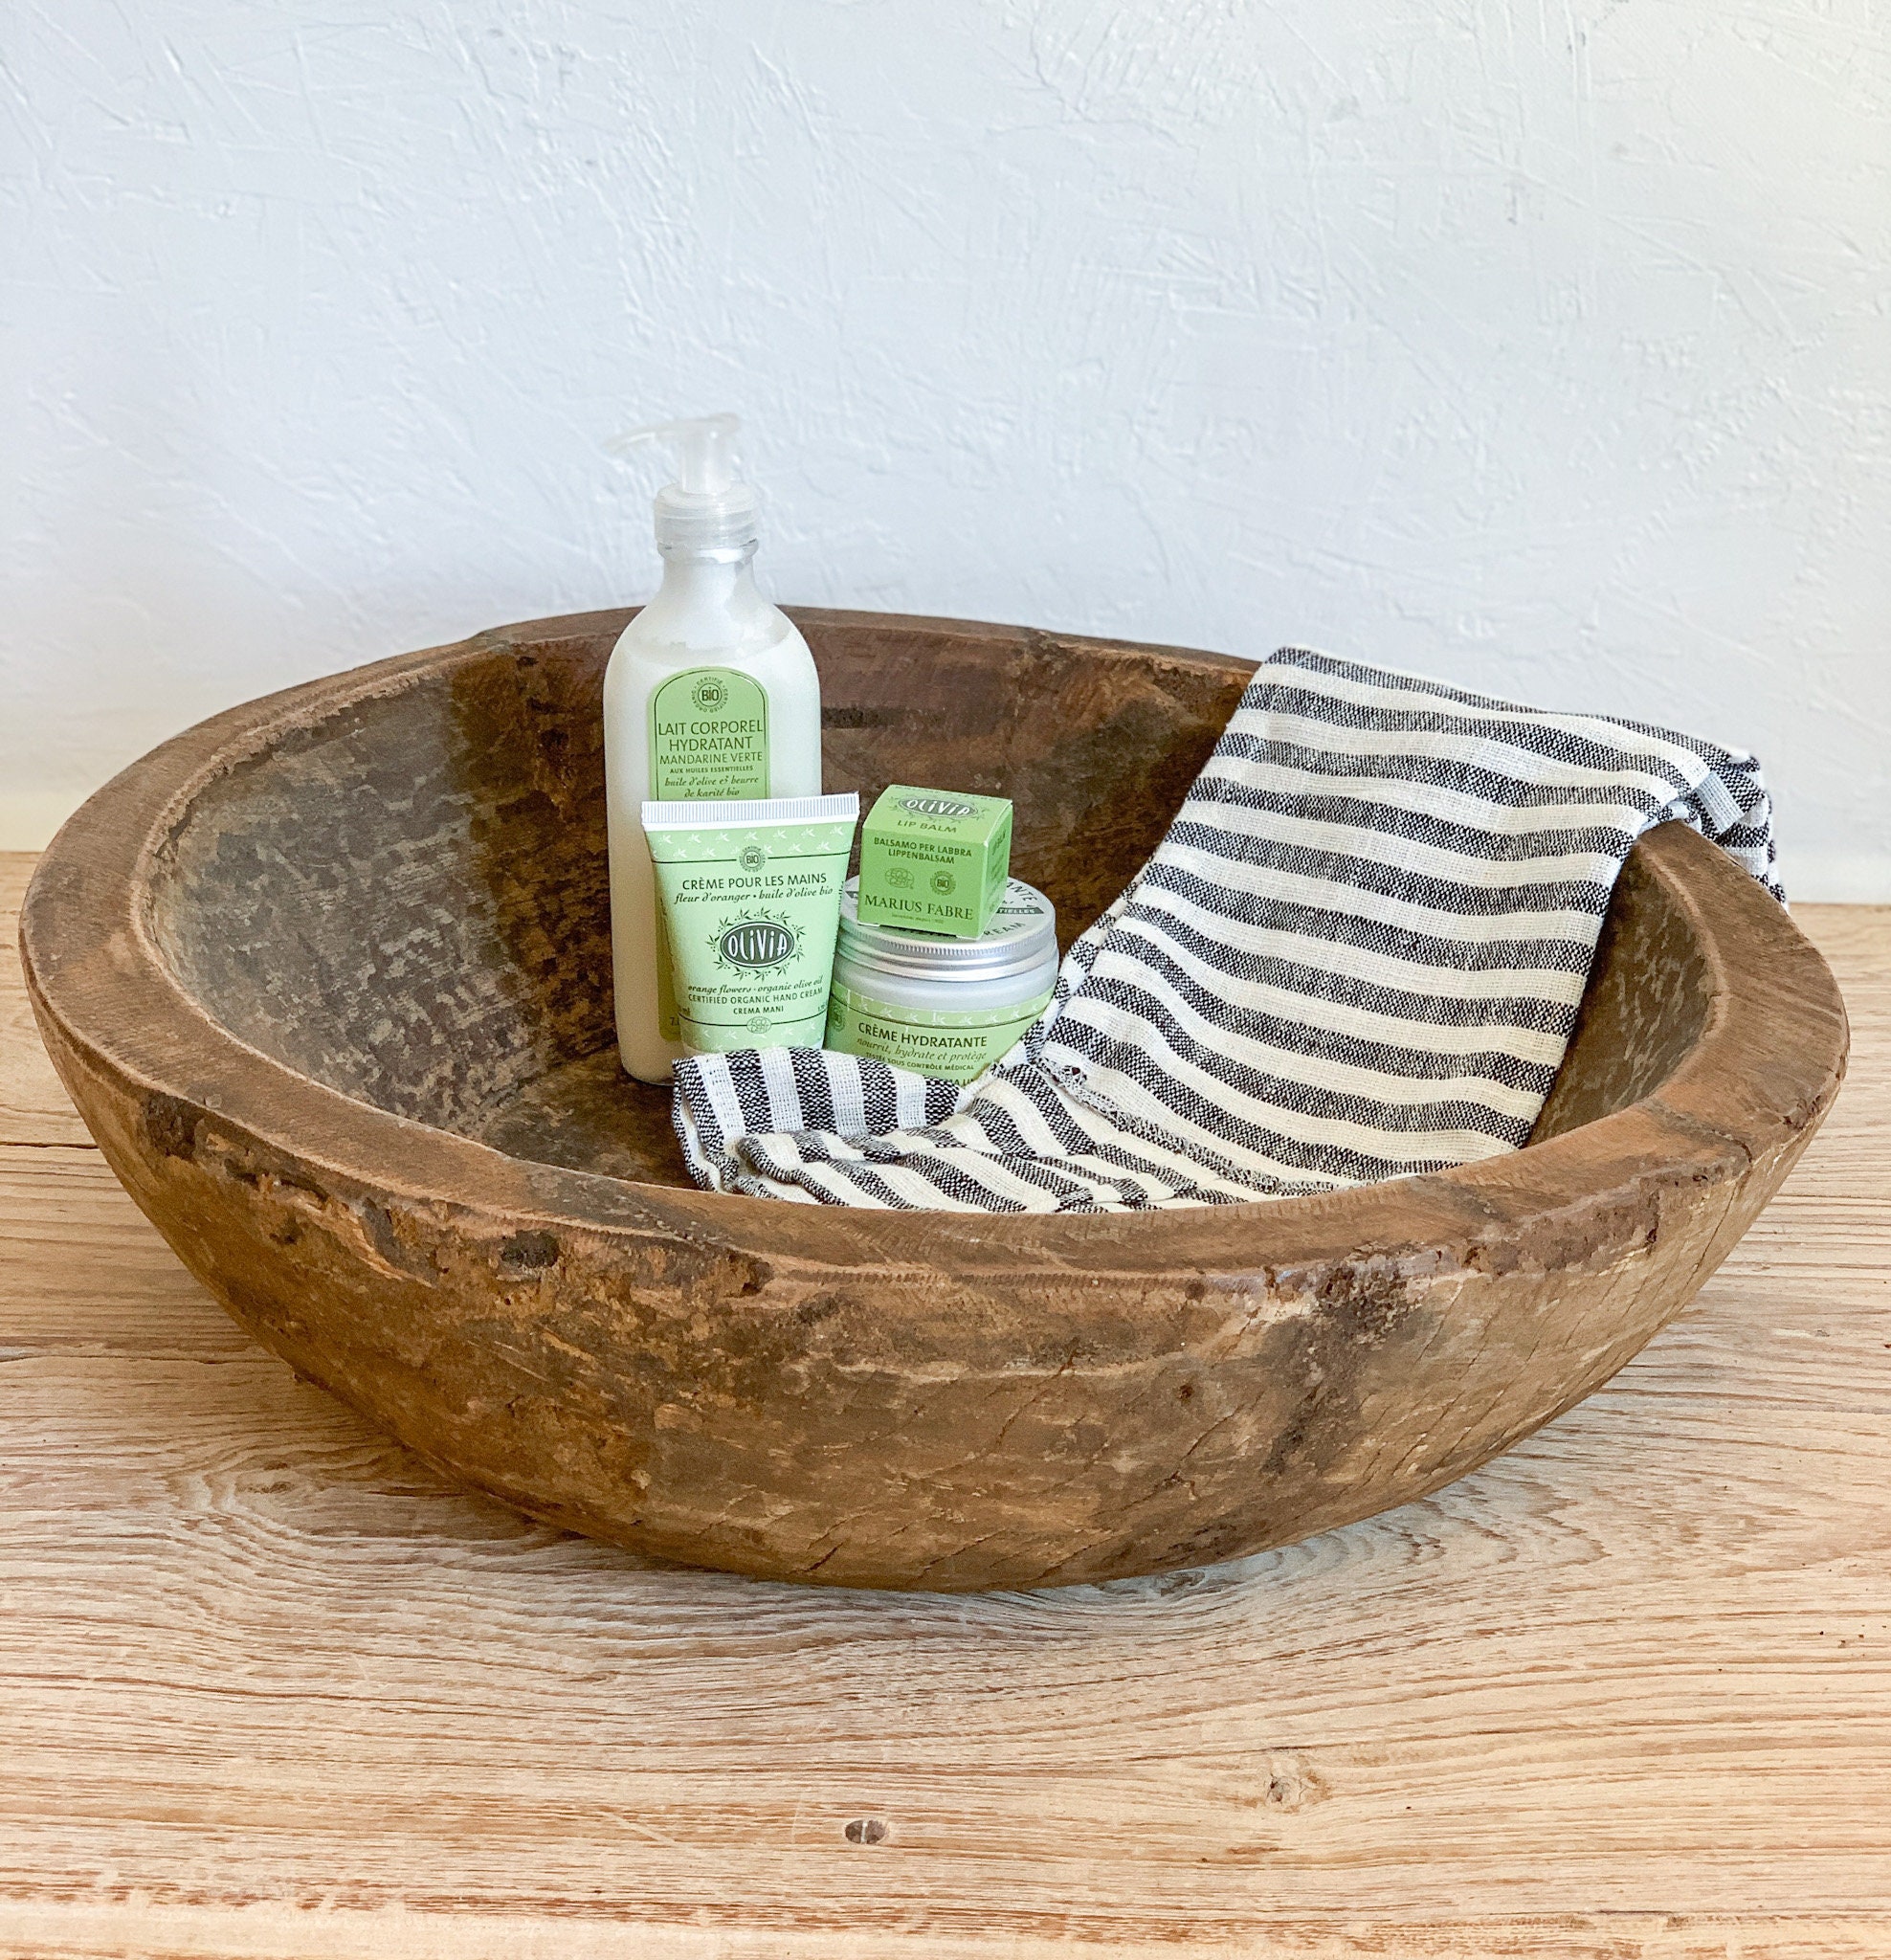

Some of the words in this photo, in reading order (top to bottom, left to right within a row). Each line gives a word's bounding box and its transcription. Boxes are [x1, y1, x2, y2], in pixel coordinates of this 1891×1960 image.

[658, 723, 686, 736] LAIT
[691, 720, 764, 735] CORPOREL
[669, 736, 753, 751] HYDRATANT
[659, 753, 728, 765] MANDARINE
[730, 751, 763, 762] VERTE
[664, 775, 686, 787] huile
[688, 776, 717, 786] d'olive
[730, 773, 759, 785] beurre
[684, 788, 695, 797] de
[697, 788, 725, 797] karité
[726, 787, 740, 796] bio
[898, 819, 917, 828] LIP
[920, 823, 957, 833] BALM
[874, 836, 917, 850] BALSAMO
[920, 842, 936, 853] PER
[937, 843, 972, 858] LABBRA
[888, 848, 955, 864] LIPPENBALSAM
[682, 877, 724, 890] CRÈME
[728, 877, 762, 888] POUR
[765, 875, 784, 886] LES
[788, 873, 827, 885] MAINS
[674, 893, 700, 904] fleur
[703, 891, 750, 903] d'oranger
[759, 887, 784, 900] huile
[787, 886, 817, 898] d'olive
[819, 884, 834, 896] bio
[864, 894, 923, 913] MARIUS
[927, 902, 973, 920] FABRE
[983, 922, 1026, 936] REAM
[688, 985, 717, 996] orange
[720, 984, 751, 996] flowers
[757, 982, 792, 996] organic
[793, 978, 812, 991] olive
[813, 974, 824, 987] oil
[688, 993, 727, 1005] CERTIFIED
[730, 995, 770, 1004] ORGANIC
[772, 991, 798, 1003] HAND
[800, 987, 823, 999] CREAM
[733, 1007, 761, 1015] CREMA
[858, 1022, 898, 1042] CRÈME
[901, 1033, 987, 1048] HYDRATANTE
[857, 1037, 891, 1054] nourrit,
[895, 1044, 935, 1059] hydrate
[937, 1051, 946, 1060] et
[947, 1051, 988, 1063] protège
[887, 1058, 905, 1066] SOUS
[906, 1061, 943, 1071] CONTRÔLE
